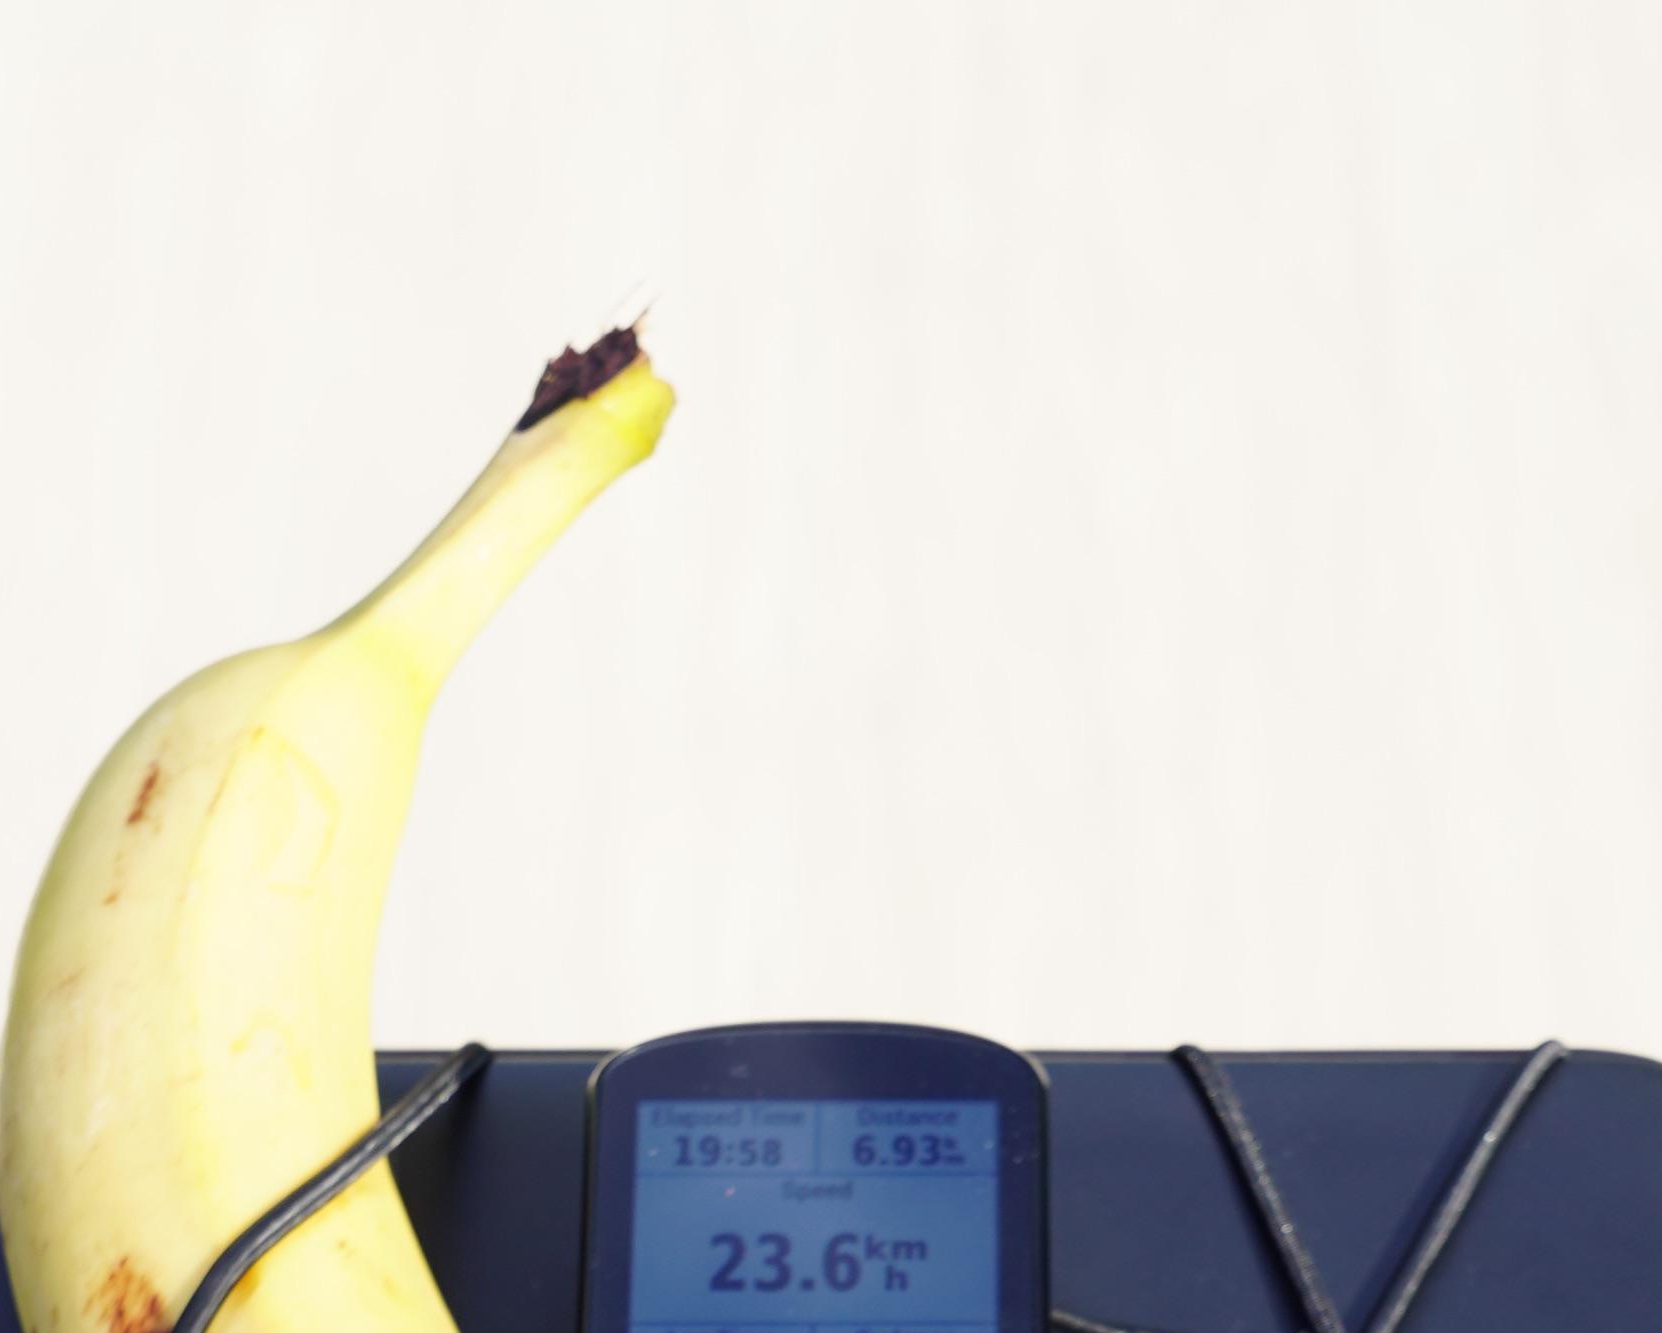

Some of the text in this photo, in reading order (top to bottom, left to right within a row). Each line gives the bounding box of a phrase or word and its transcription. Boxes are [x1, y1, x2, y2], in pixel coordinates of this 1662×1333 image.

[749, 1106, 806, 1126] Time
[856, 1105, 958, 1127] Distance
[674, 1134, 783, 1168] 19:58
[852, 1134, 942, 1167] 6.93
[782, 1181, 854, 1202] Speed
[708, 1231, 862, 1293] 23.6
